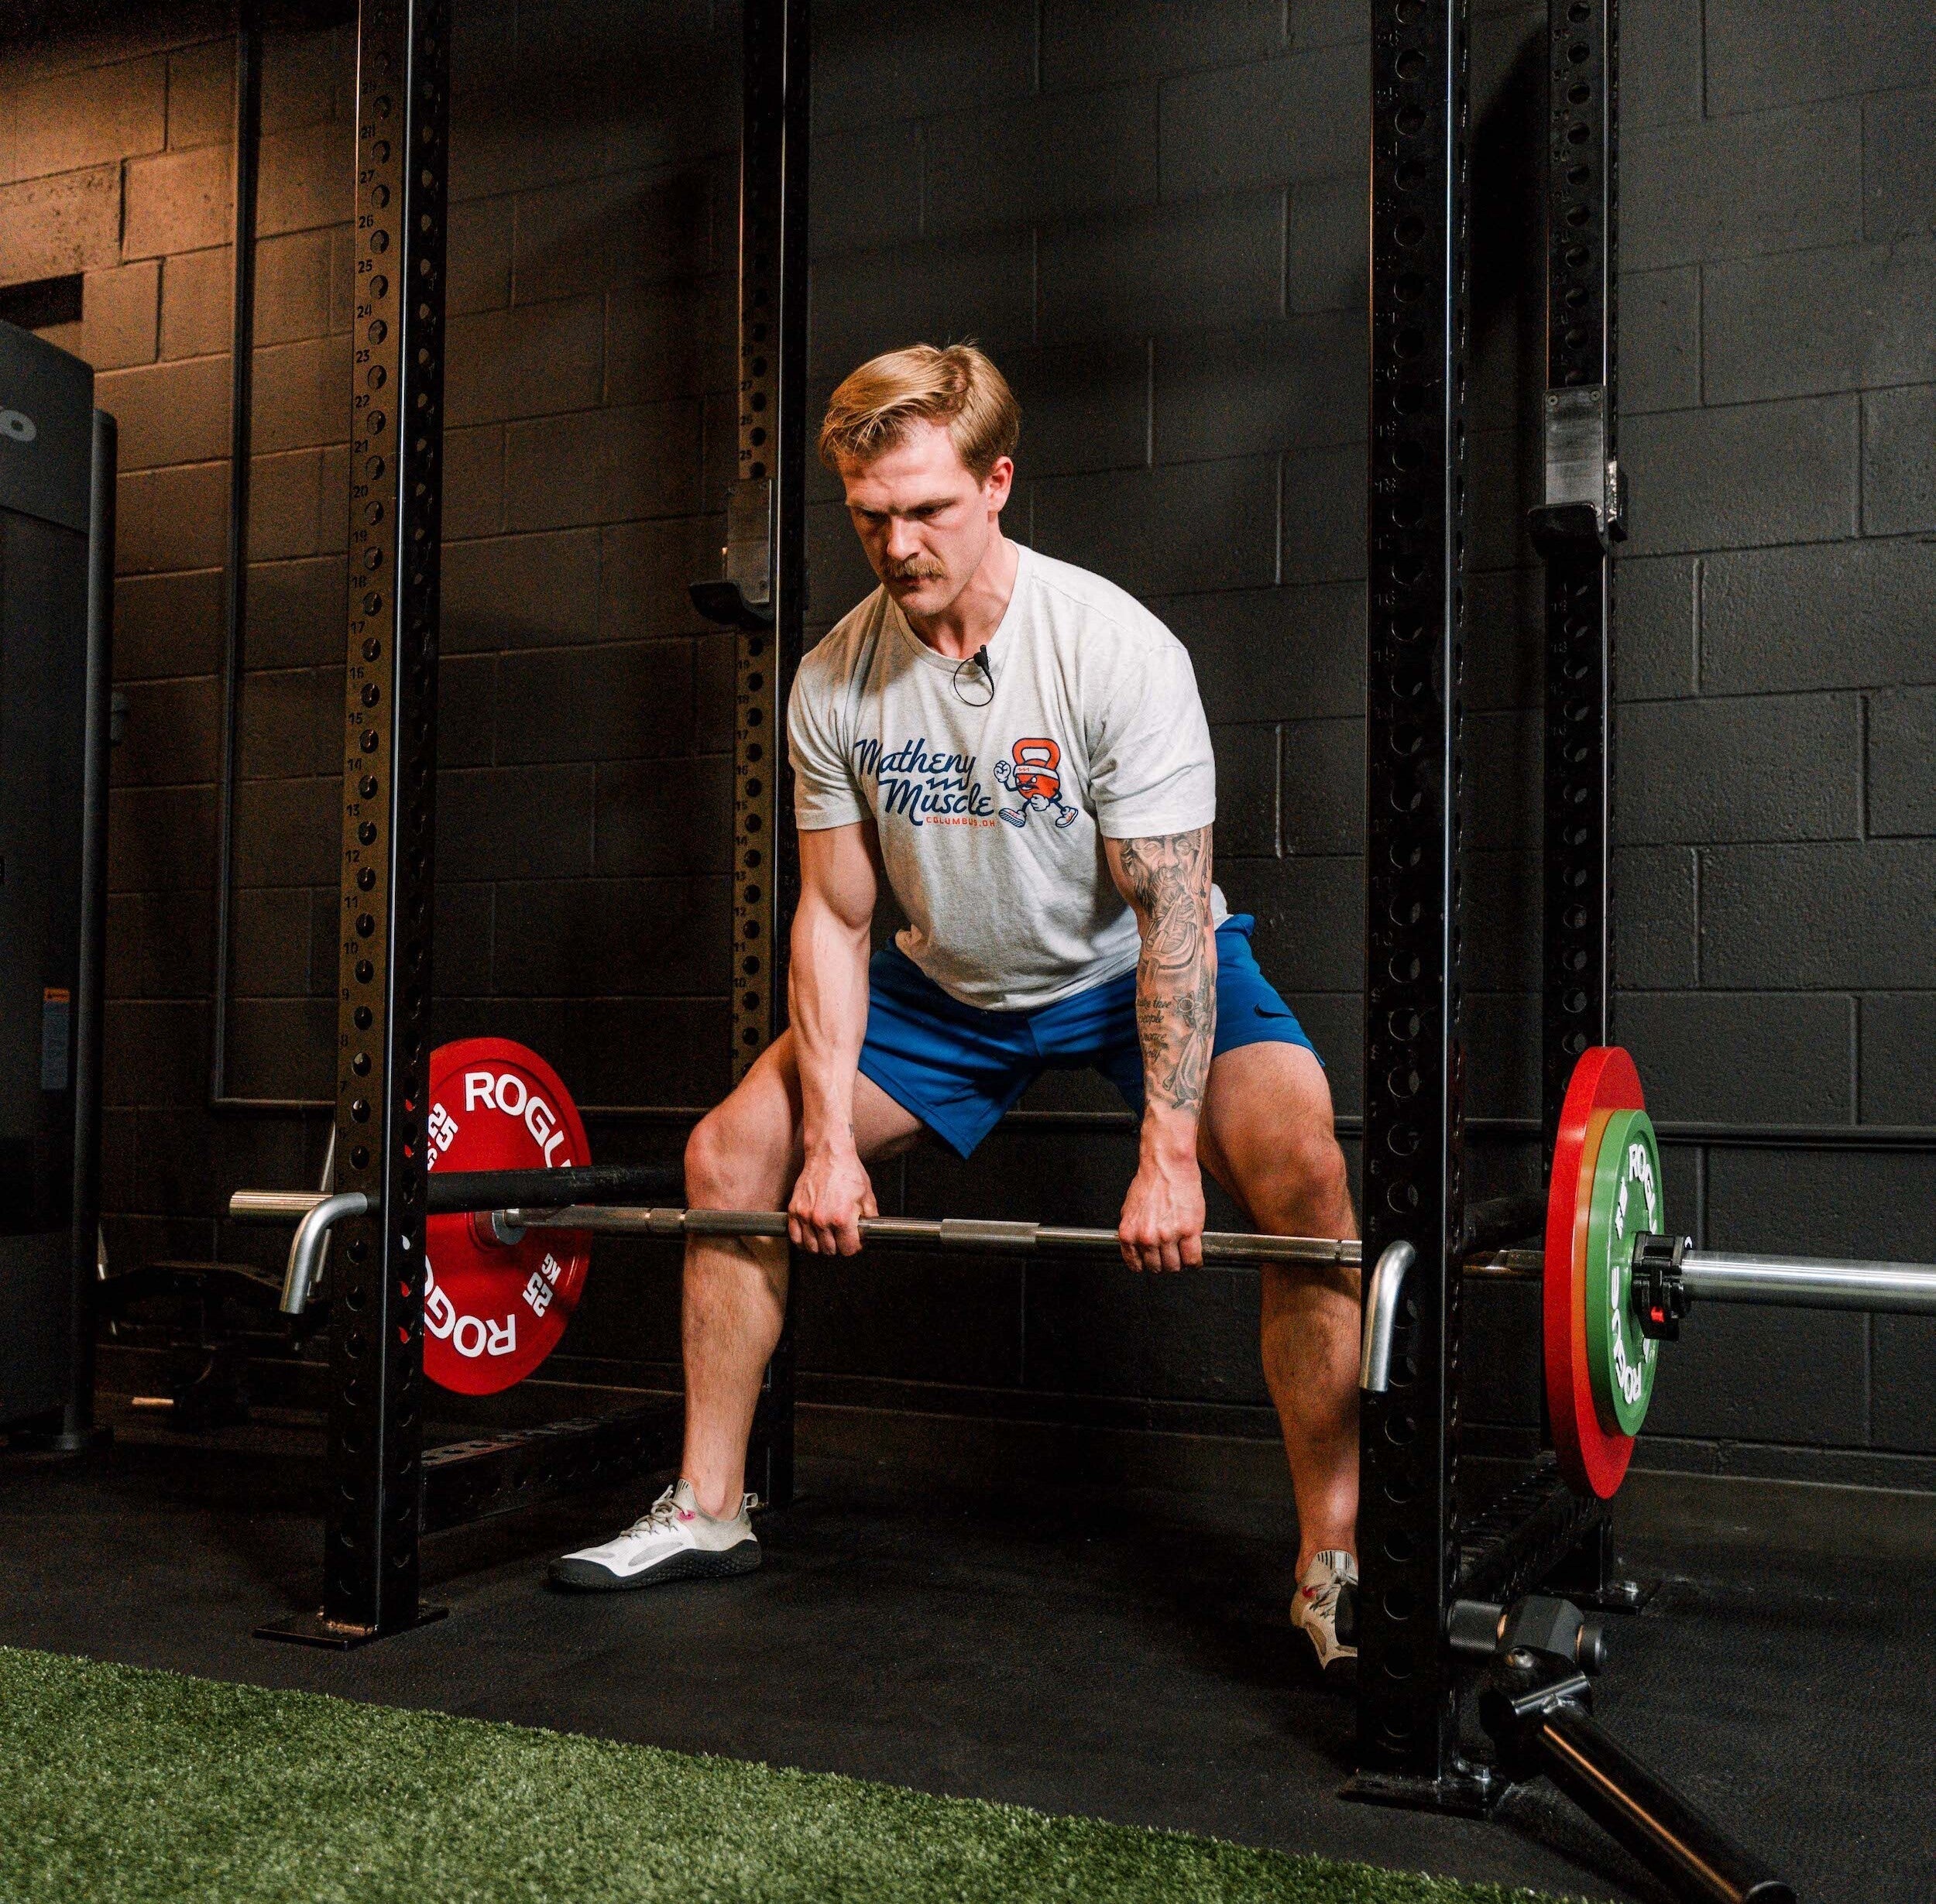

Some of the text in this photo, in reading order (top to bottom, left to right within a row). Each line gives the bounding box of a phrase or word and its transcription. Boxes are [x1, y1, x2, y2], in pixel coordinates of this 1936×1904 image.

[360, 170, 374, 184] 27
[359, 214, 373, 228] 26
[358, 259, 372, 273] 25
[357, 304, 372, 318] 24
[355, 349, 370, 363] 23
[355, 394, 369, 408] 22
[354, 440, 369, 454] 21
[740, 450, 752, 461] 25
[353, 484, 369, 498] 20
[352, 530, 367, 543] 19
[352, 575, 366, 588] 18
[351, 621, 365, 634] 17
[349, 667, 364, 680] 16
[348, 712, 362, 725] 15
[348, 757, 362, 770] 14
[853, 737, 977, 777] Matheny
[878, 777, 994, 826] Muscle
[346, 803, 360, 816] 13
[345, 849, 359, 863] 12
[344, 896, 358, 908] 11
[343, 942, 359, 954] 10
[342, 988, 349, 1000] 9
[340, 1034, 348, 1047] 8
[340, 1080, 348, 1093] 7
[428, 1103, 458, 1152] 25
[522, 1253, 561, 1318] 25 KG
